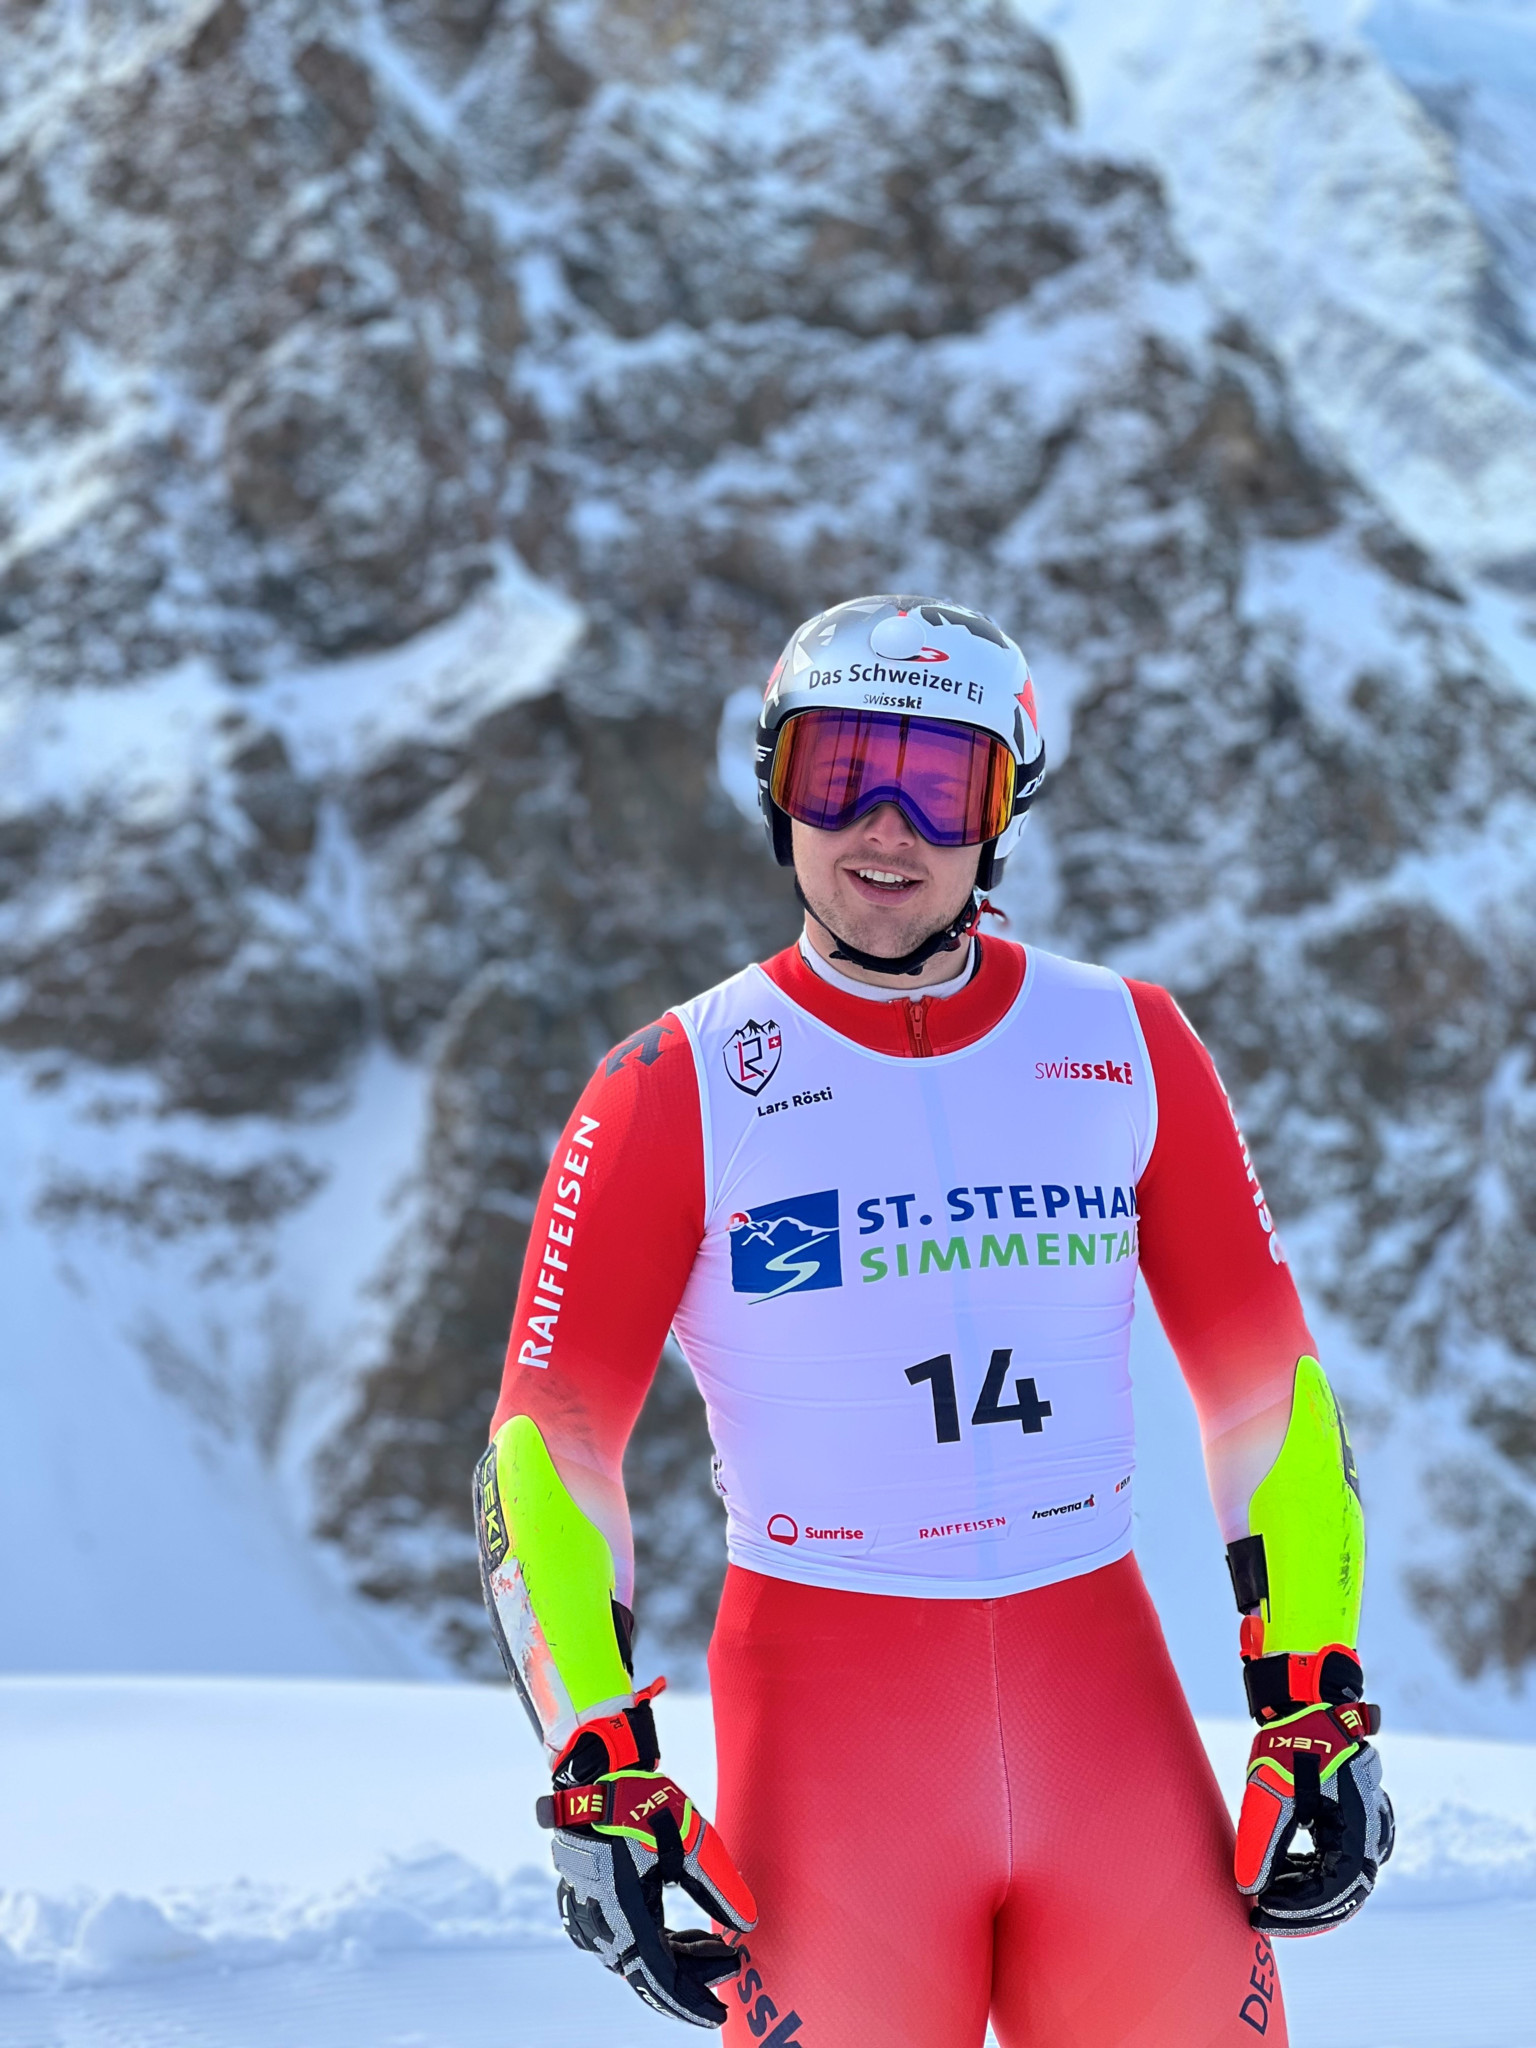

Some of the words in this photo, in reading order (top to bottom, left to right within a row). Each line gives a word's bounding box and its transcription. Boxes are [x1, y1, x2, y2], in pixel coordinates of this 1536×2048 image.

[809, 669, 842, 690] Das
[848, 663, 962, 695] Schweizer
[967, 681, 984, 705] Ei
[863, 692, 922, 710] swissski
[1035, 1056, 1133, 1085] swissski
[757, 1100, 789, 1117] Lars
[792, 1086, 833, 1108] Rösti
[856, 1193, 932, 1235] ST.
[517, 1114, 601, 1370] RAIFFEISEN
[904, 1348, 1053, 1444] 14
[483, 1451, 503, 1553] LEKI
[805, 1525, 864, 1541] Sunrise
[918, 1516, 1006, 1540] RAIFFEISEN
[1268, 1736, 1332, 1754] LEKI
[570, 1794, 604, 1816] EKI
[629, 1785, 679, 1822] LEKI
